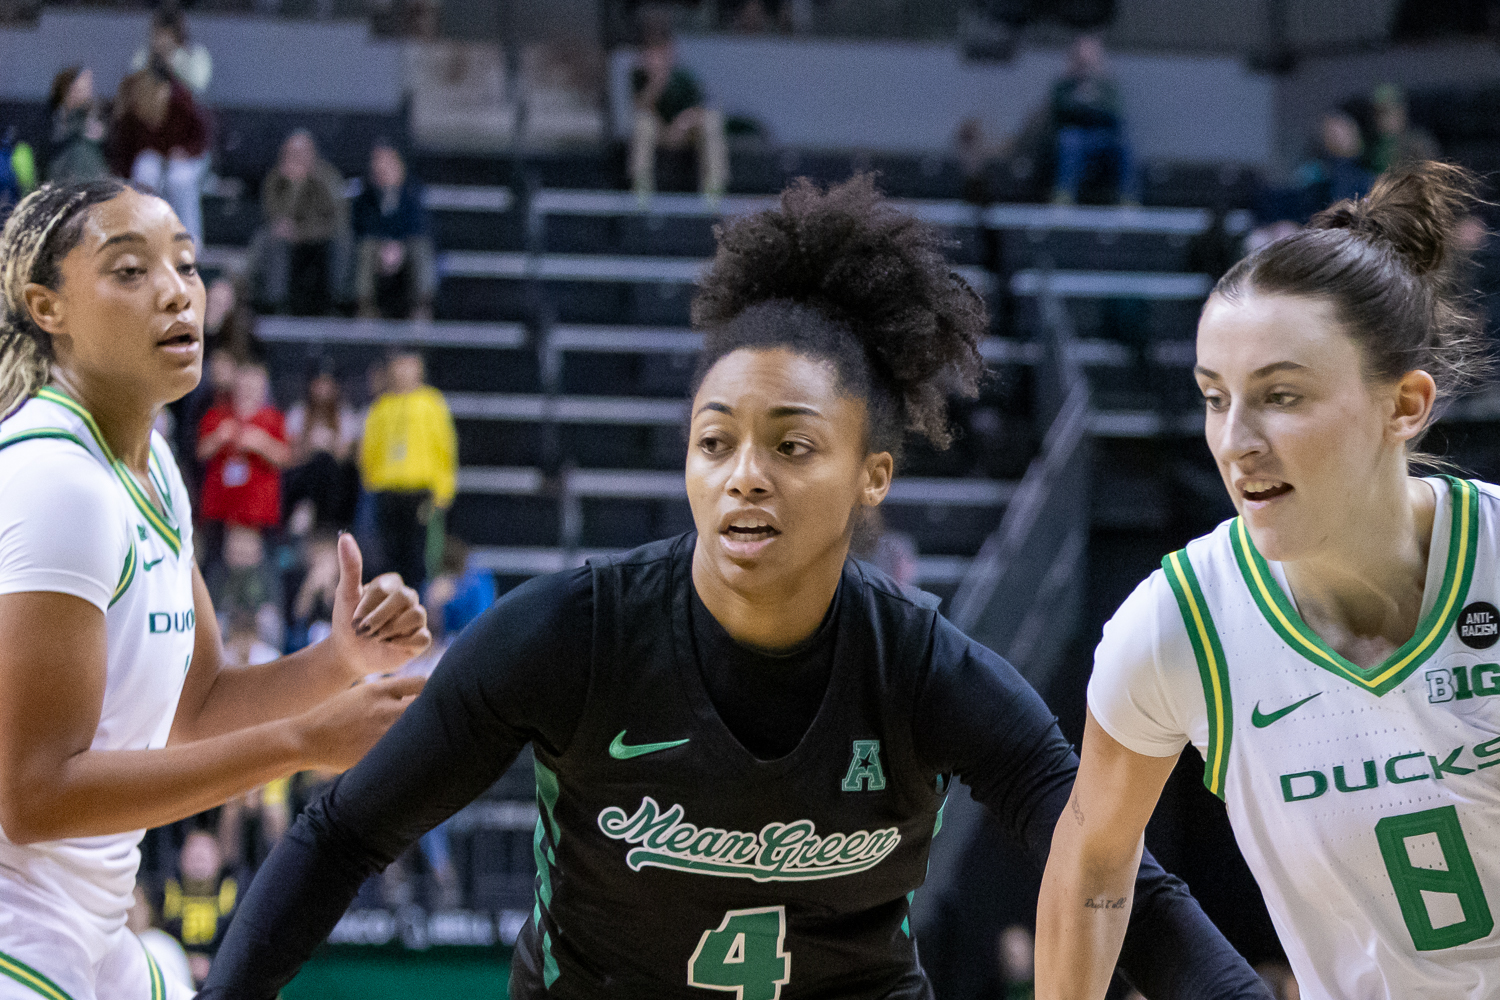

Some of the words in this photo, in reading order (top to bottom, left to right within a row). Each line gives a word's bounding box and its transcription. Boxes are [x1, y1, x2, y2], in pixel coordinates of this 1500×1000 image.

[1461, 623, 1498, 637] RACISM
[1466, 612, 1494, 625] ANTI-
[597, 796, 761, 865] Mean
[752, 819, 901, 874] Green
[1374, 804, 1495, 952] 8
